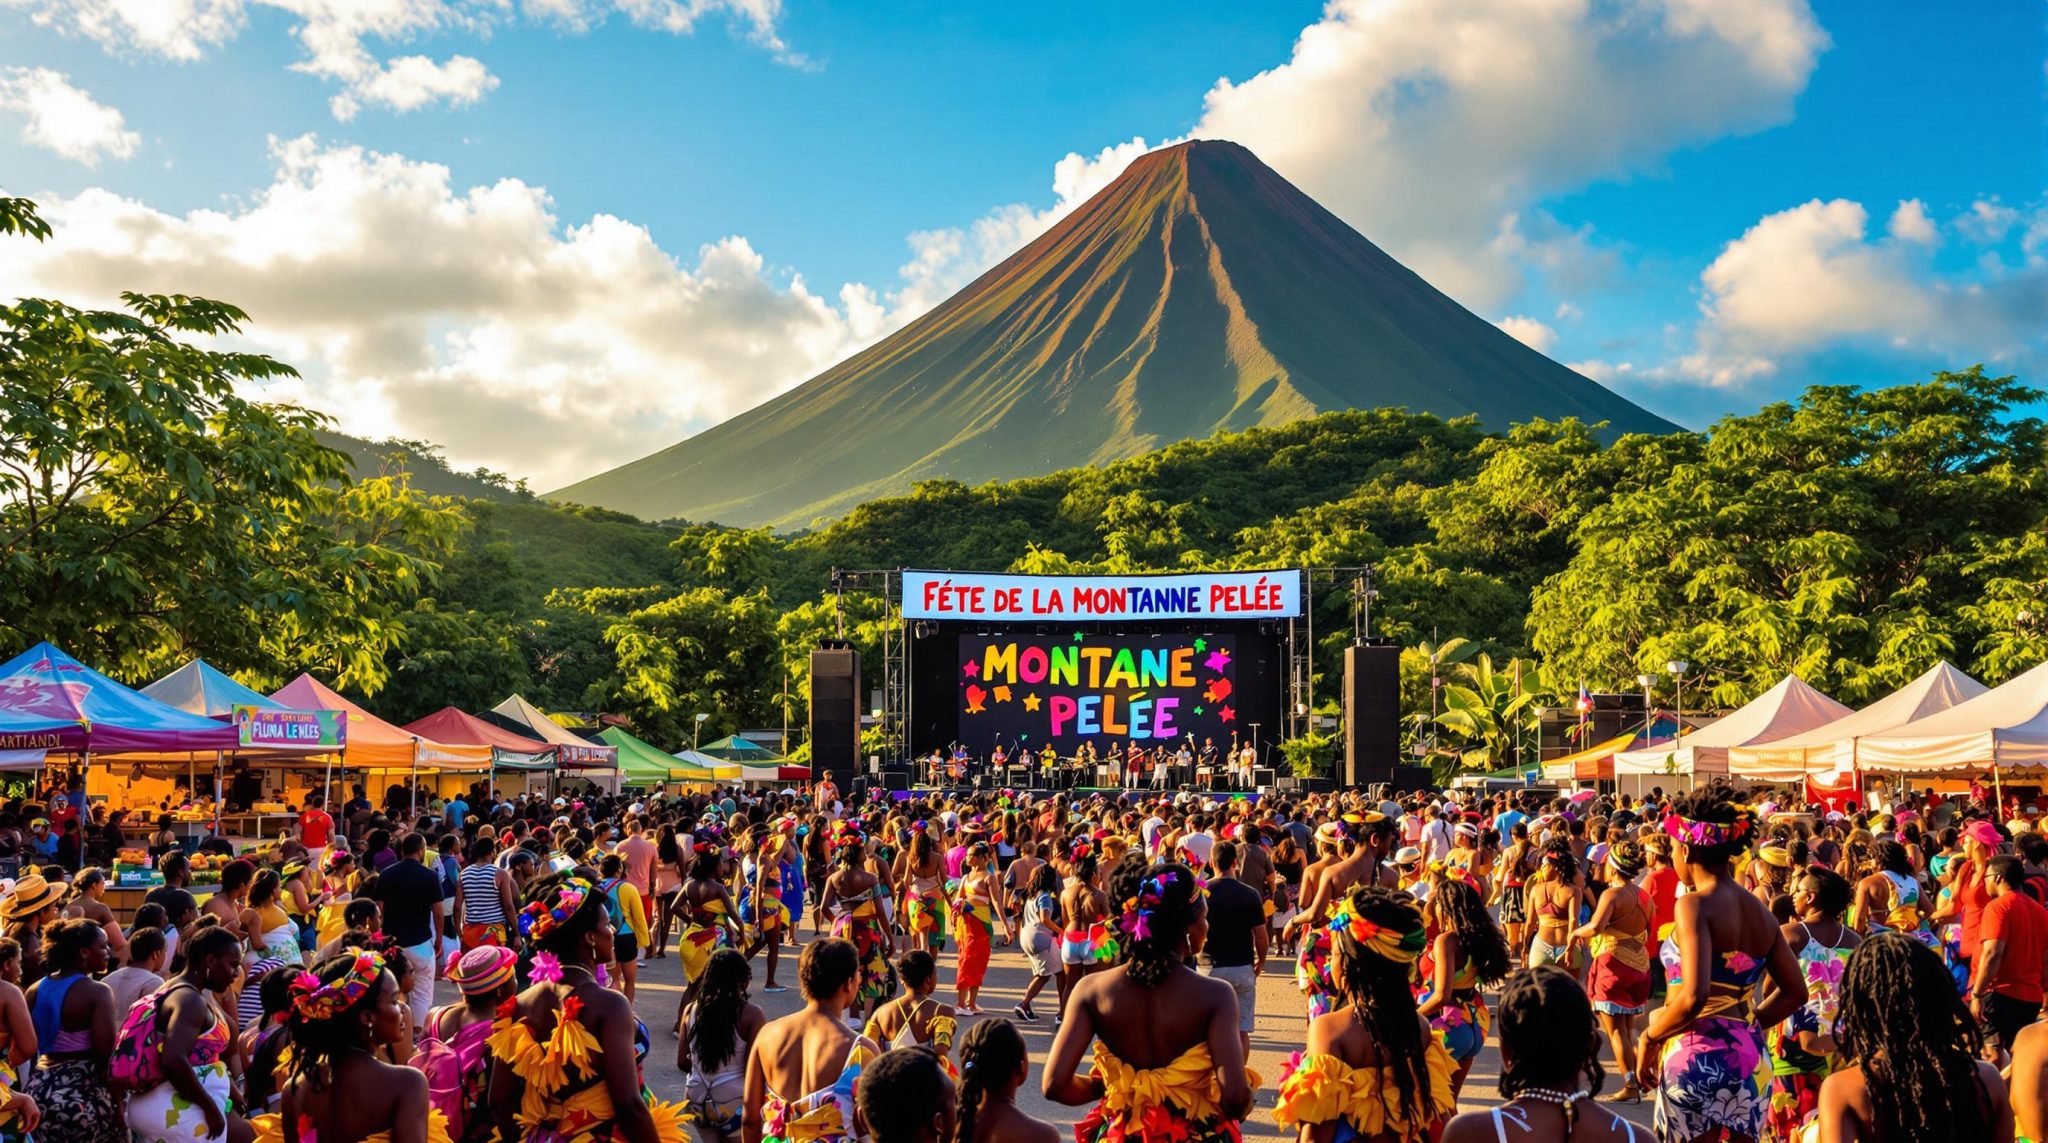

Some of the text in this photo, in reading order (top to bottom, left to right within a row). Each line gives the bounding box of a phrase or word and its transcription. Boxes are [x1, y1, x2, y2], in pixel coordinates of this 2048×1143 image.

[993, 588, 1023, 613] DE
[1032, 588, 1064, 614] LA
[1073, 586, 1202, 614] MONTANNE
[1209, 575, 1284, 613] PELÉE
[982, 642, 1197, 689] MONTANE
[1049, 691, 1180, 740] PELÉE
